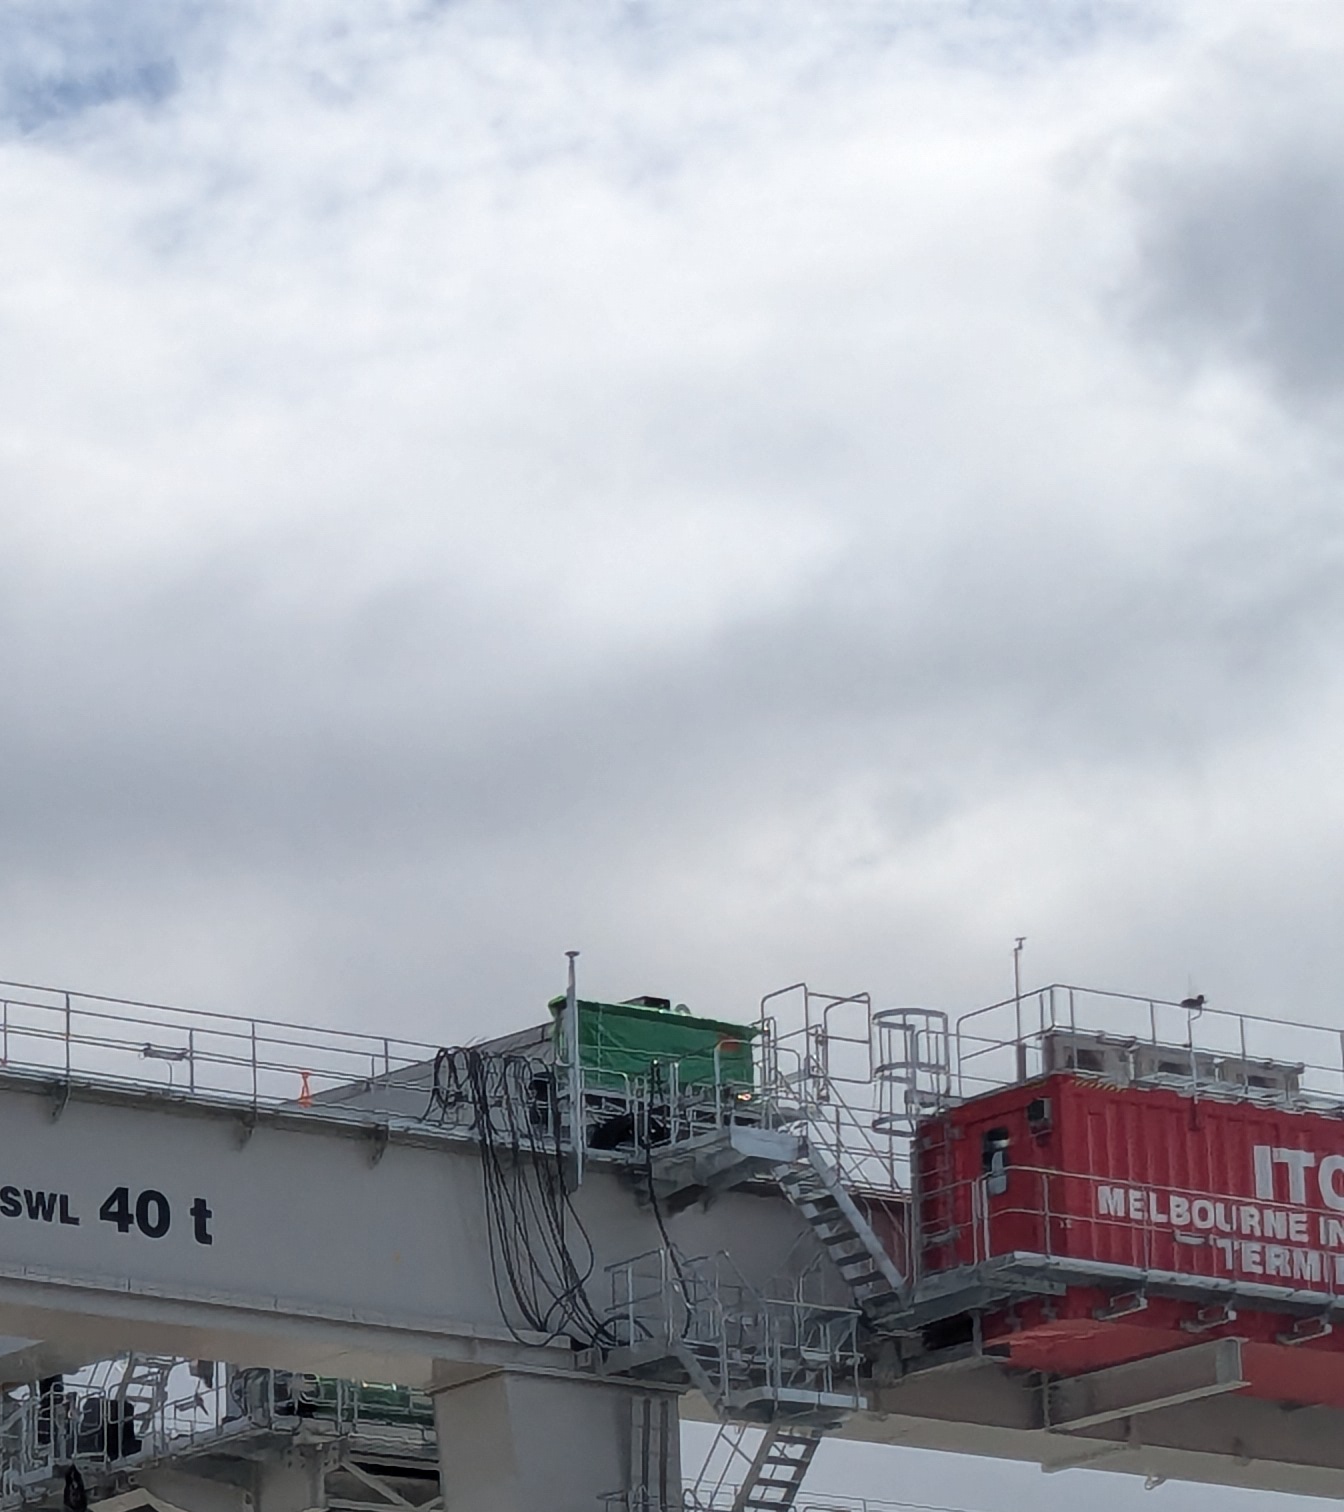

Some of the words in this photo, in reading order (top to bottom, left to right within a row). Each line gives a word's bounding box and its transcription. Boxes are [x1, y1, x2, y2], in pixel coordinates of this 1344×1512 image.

[0, 1185, 80, 1226] SWL
[99, 1187, 171, 1238] 40
[190, 1197, 213, 1245] t
[1098, 1185, 1309, 1242] MELBOURNE
